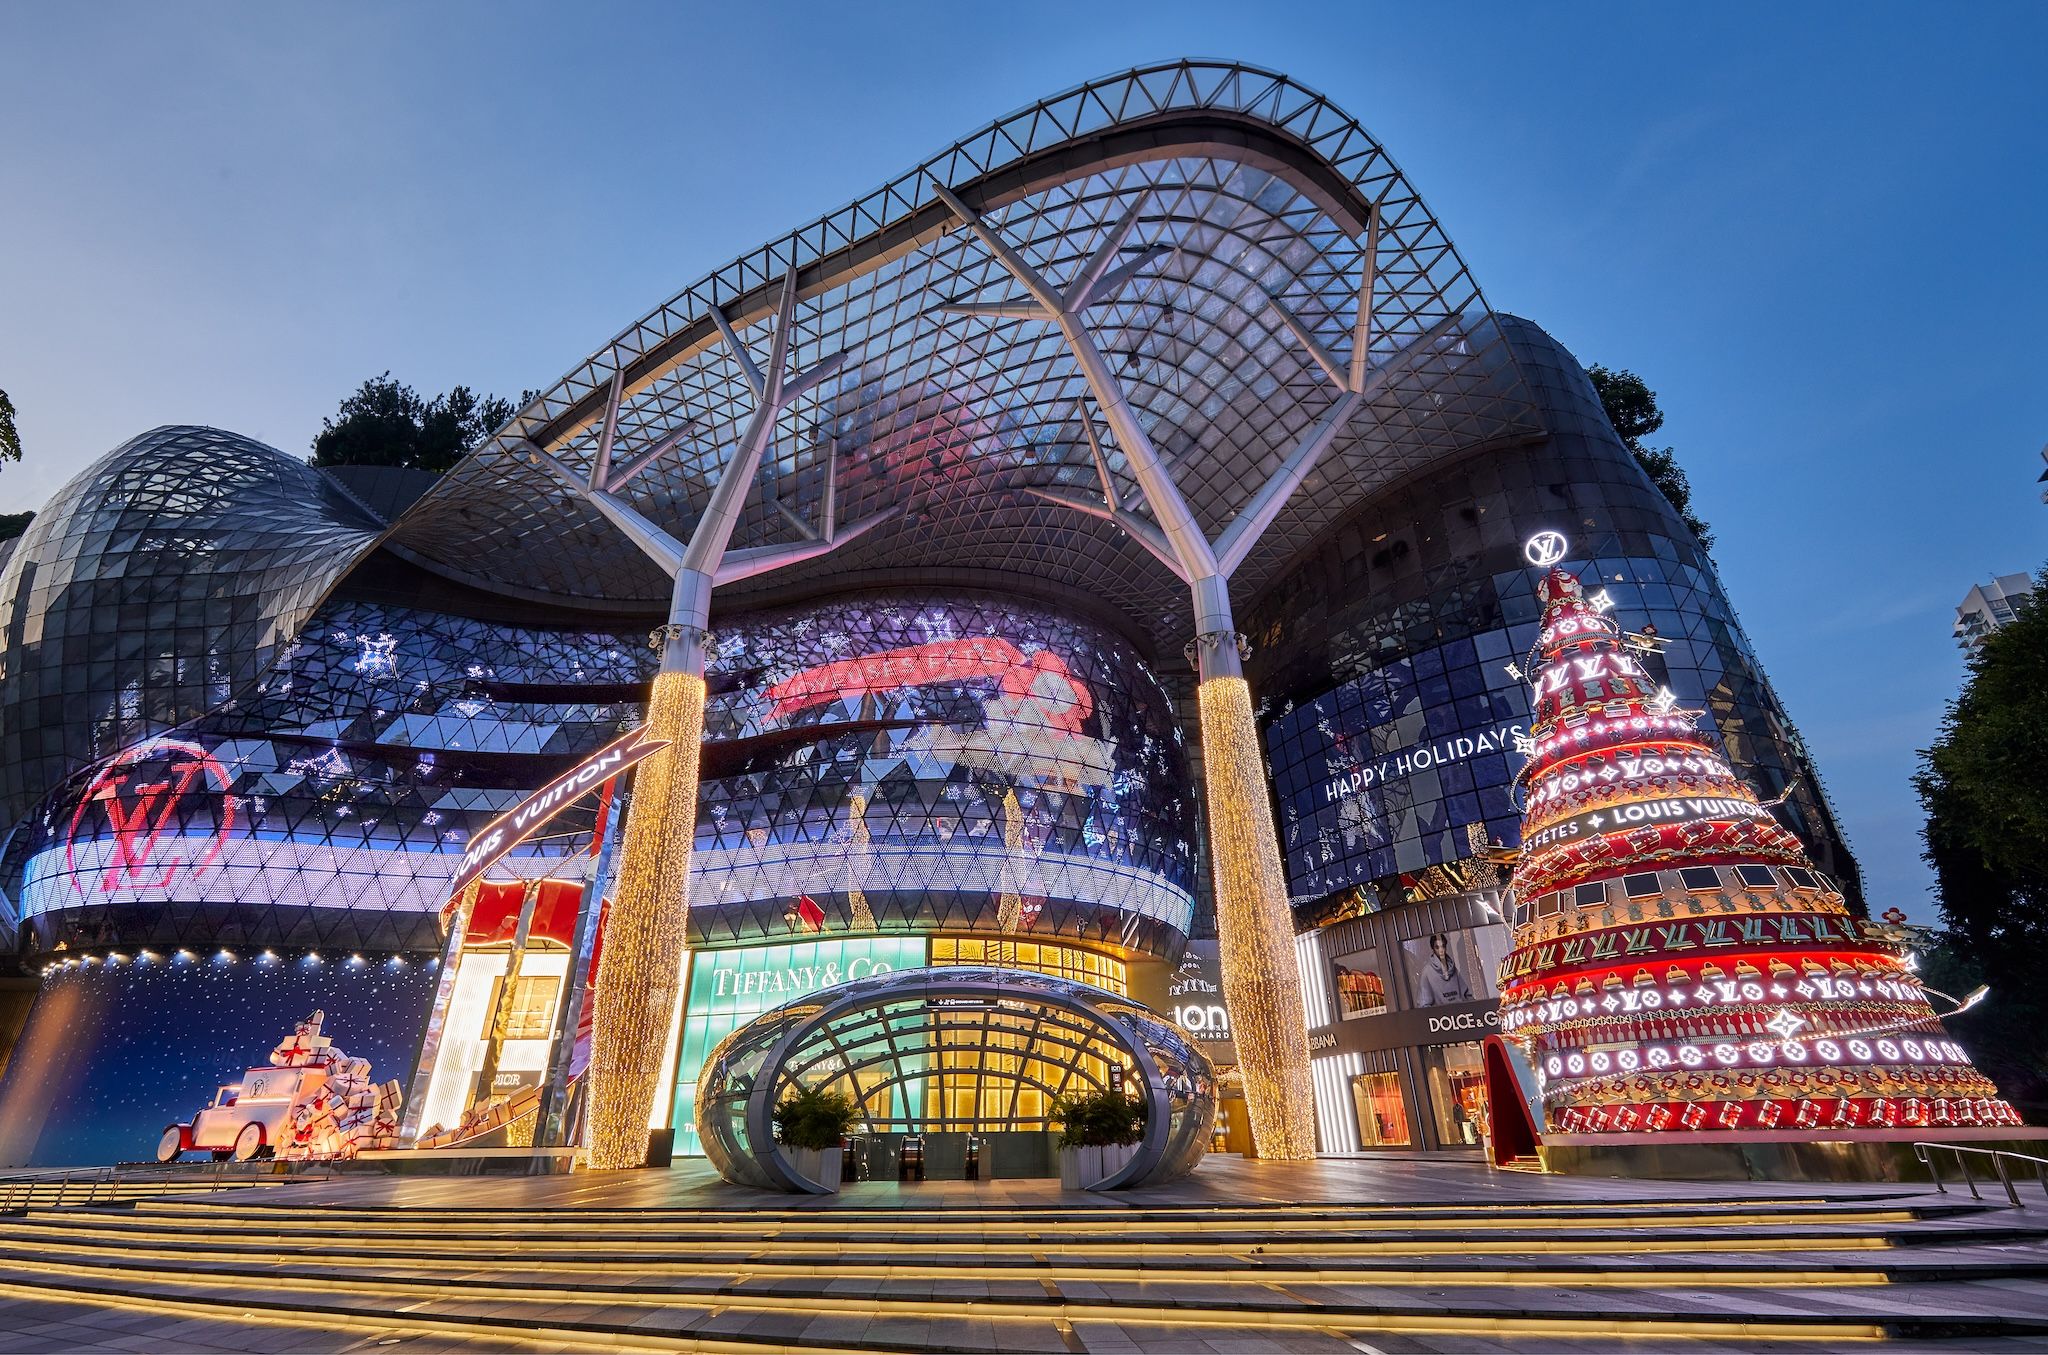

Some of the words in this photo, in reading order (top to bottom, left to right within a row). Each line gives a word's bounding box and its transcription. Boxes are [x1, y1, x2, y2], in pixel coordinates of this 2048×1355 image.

[1325, 761, 1387, 801] HAPPY
[1396, 725, 1526, 776] HOLIDAYS
[514, 749, 622, 829] VUITTON
[1535, 822, 1578, 848] FÊTES
[1614, 799, 1685, 824] LOUIS
[1685, 799, 1770, 819] VUITTON
[713, 966, 821, 996] TIFFANY
[821, 961, 843, 989] &
[1310, 1033, 1337, 1050] BBANA
[1429, 1013, 1476, 1033] DOLCE
[1476, 1018, 1484, 1028] &
